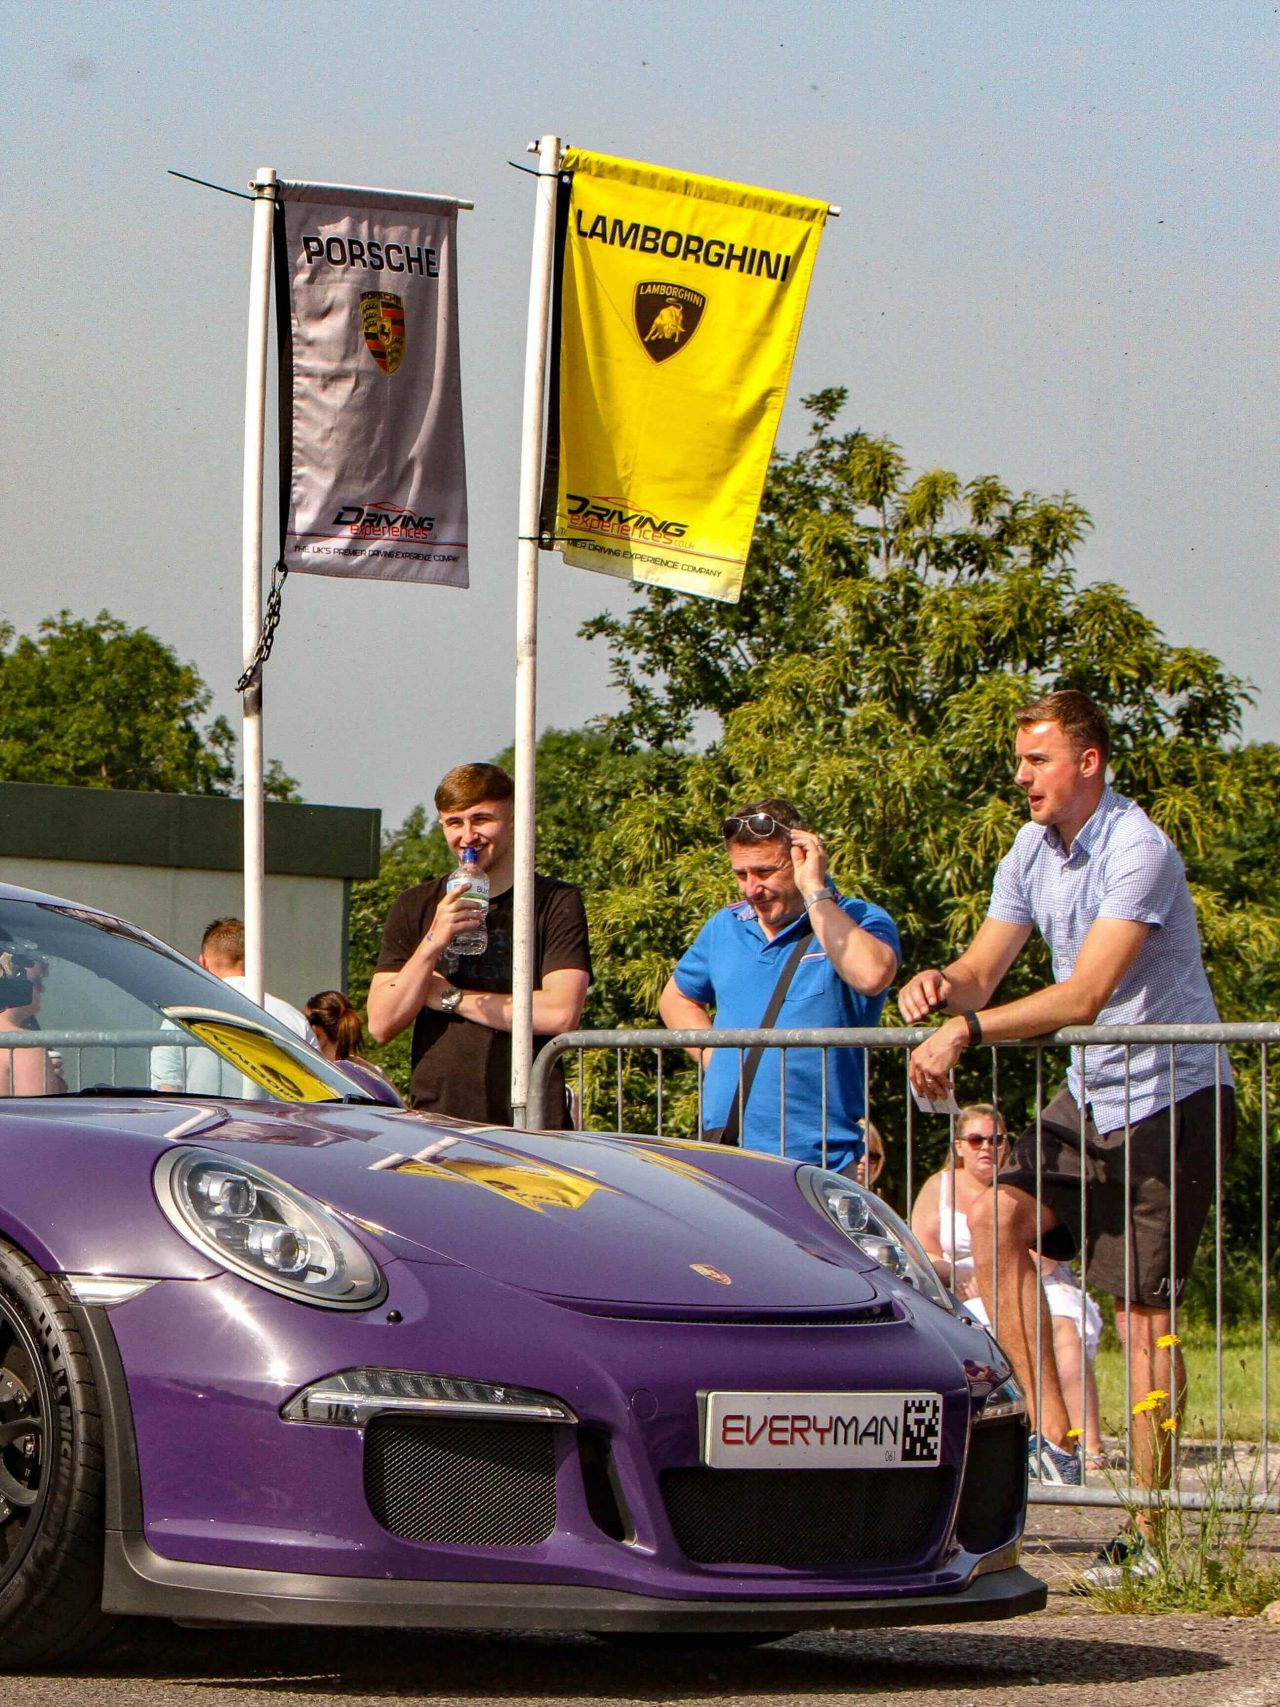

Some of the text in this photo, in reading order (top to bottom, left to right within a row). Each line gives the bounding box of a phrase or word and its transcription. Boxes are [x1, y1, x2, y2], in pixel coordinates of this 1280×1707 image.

[302, 235, 440, 278] PORSCHE
[576, 208, 792, 282] LAMBORGHINI
[639, 284, 703, 307] LAMBORGHINI
[332, 506, 436, 531] DRIVING
[351, 523, 429, 540] experiences
[570, 513, 673, 545] experiences
[294, 545, 310, 553] THE
[312, 545, 332, 555] UK'S
[588, 542, 621, 557] DRIVING
[622, 549, 679, 569] EXPERIENCE
[681, 562, 722, 577] COMPANY
[721, 1414, 899, 1446] EVERYMAN
